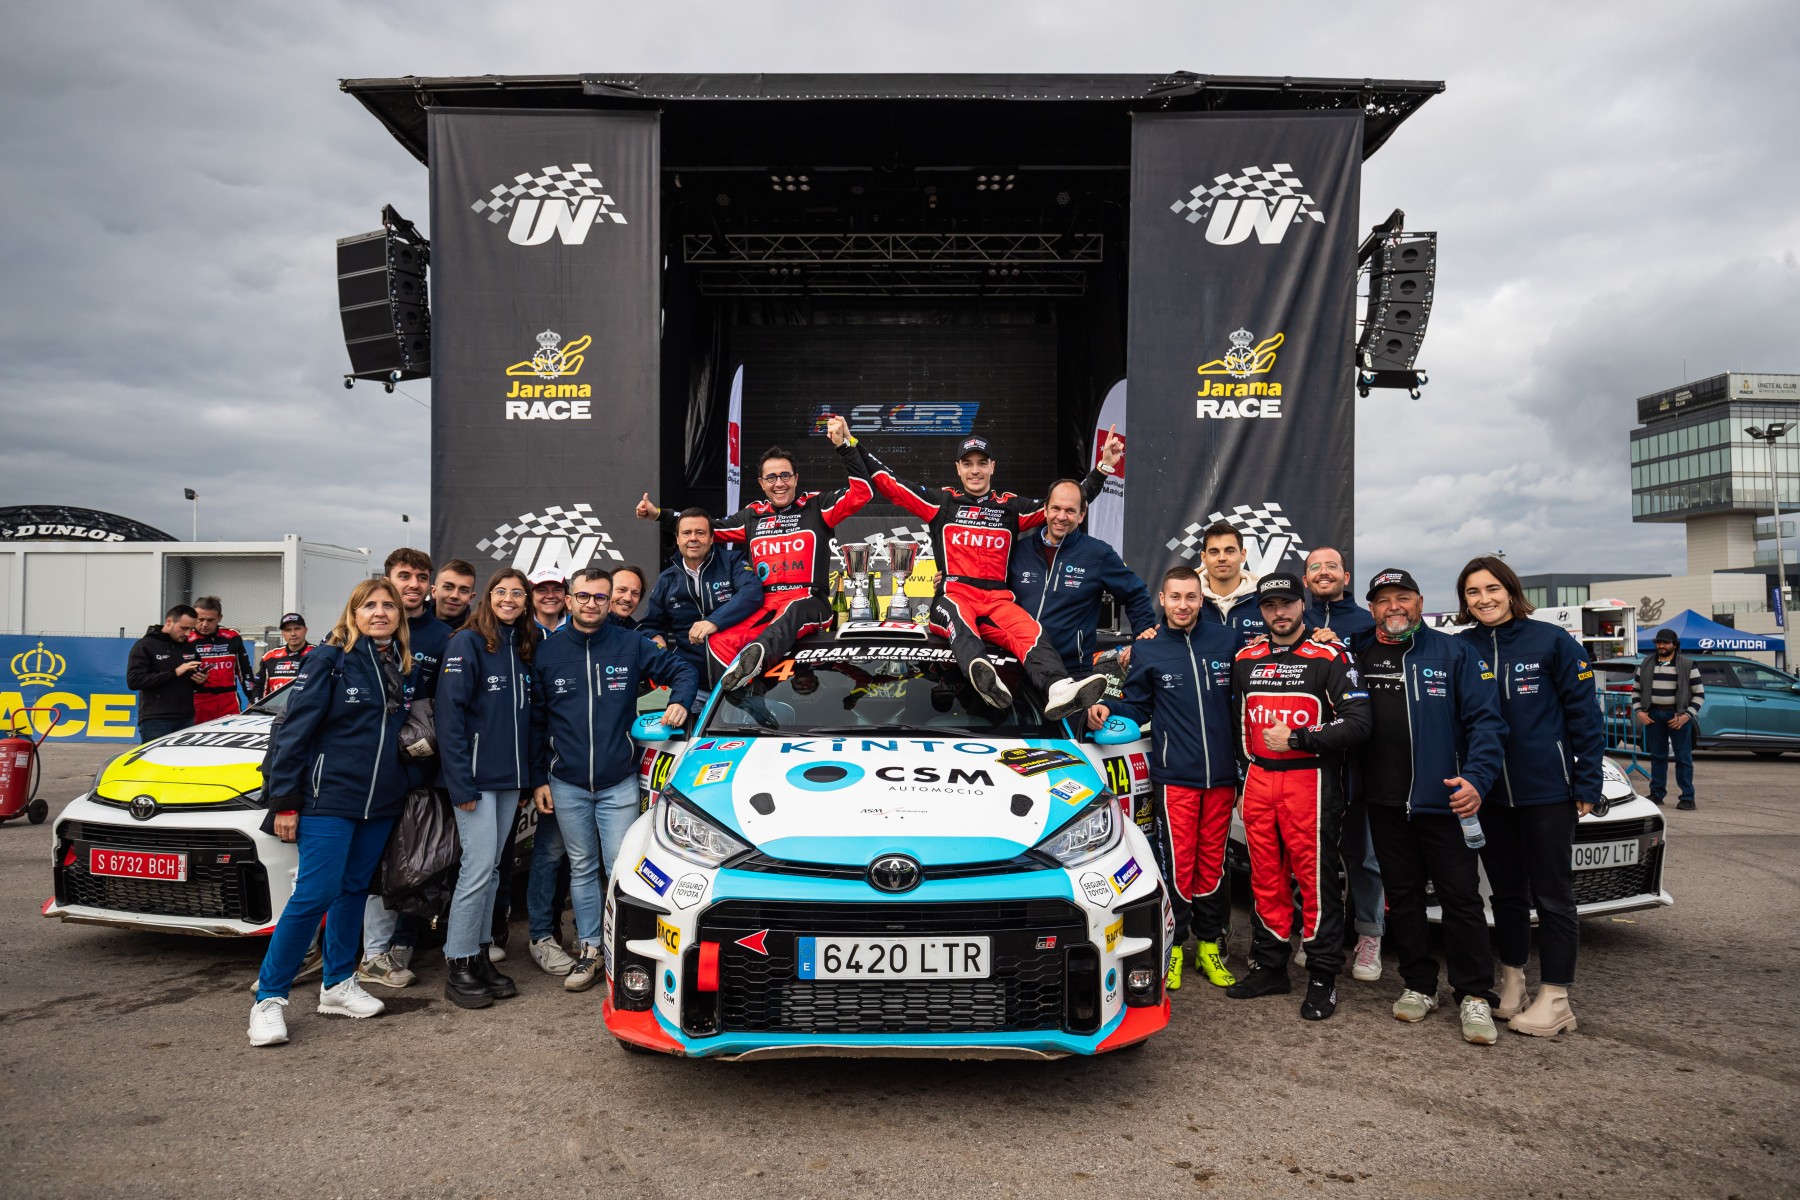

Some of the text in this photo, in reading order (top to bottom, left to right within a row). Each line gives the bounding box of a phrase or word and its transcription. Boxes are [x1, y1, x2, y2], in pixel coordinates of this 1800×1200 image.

[506, 381, 592, 398] Jarama
[1198, 379, 1282, 397] Jarama
[505, 401, 592, 420] RACE
[1196, 399, 1282, 419] RACE
[14, 524, 126, 542] DUNLOP
[772, 560, 805, 573] CSM
[1260, 579, 1290, 593] sparco
[795, 646, 858, 660] GRAN
[1717, 639, 1766, 650] HYUNDAI
[653, 754, 673, 791] 14
[875, 766, 995, 787] CSM
[1106, 758, 1129, 795] 14
[1575, 845, 1610, 866] 0907
[98, 854, 175, 876] S 6732 BCH
[642, 866, 666, 889] MICHELIN
[678, 880, 704, 891] SEGURO
[1083, 880, 1106, 890] SEGURO
[676, 888, 699, 898] TOYOTA
[1088, 888, 1109, 897] TOYOTA
[658, 920, 678, 950] RACC
[804, 962, 810, 971] E
[823, 943, 982, 974] 6420 LTR
[663, 991, 675, 1006] CSM
